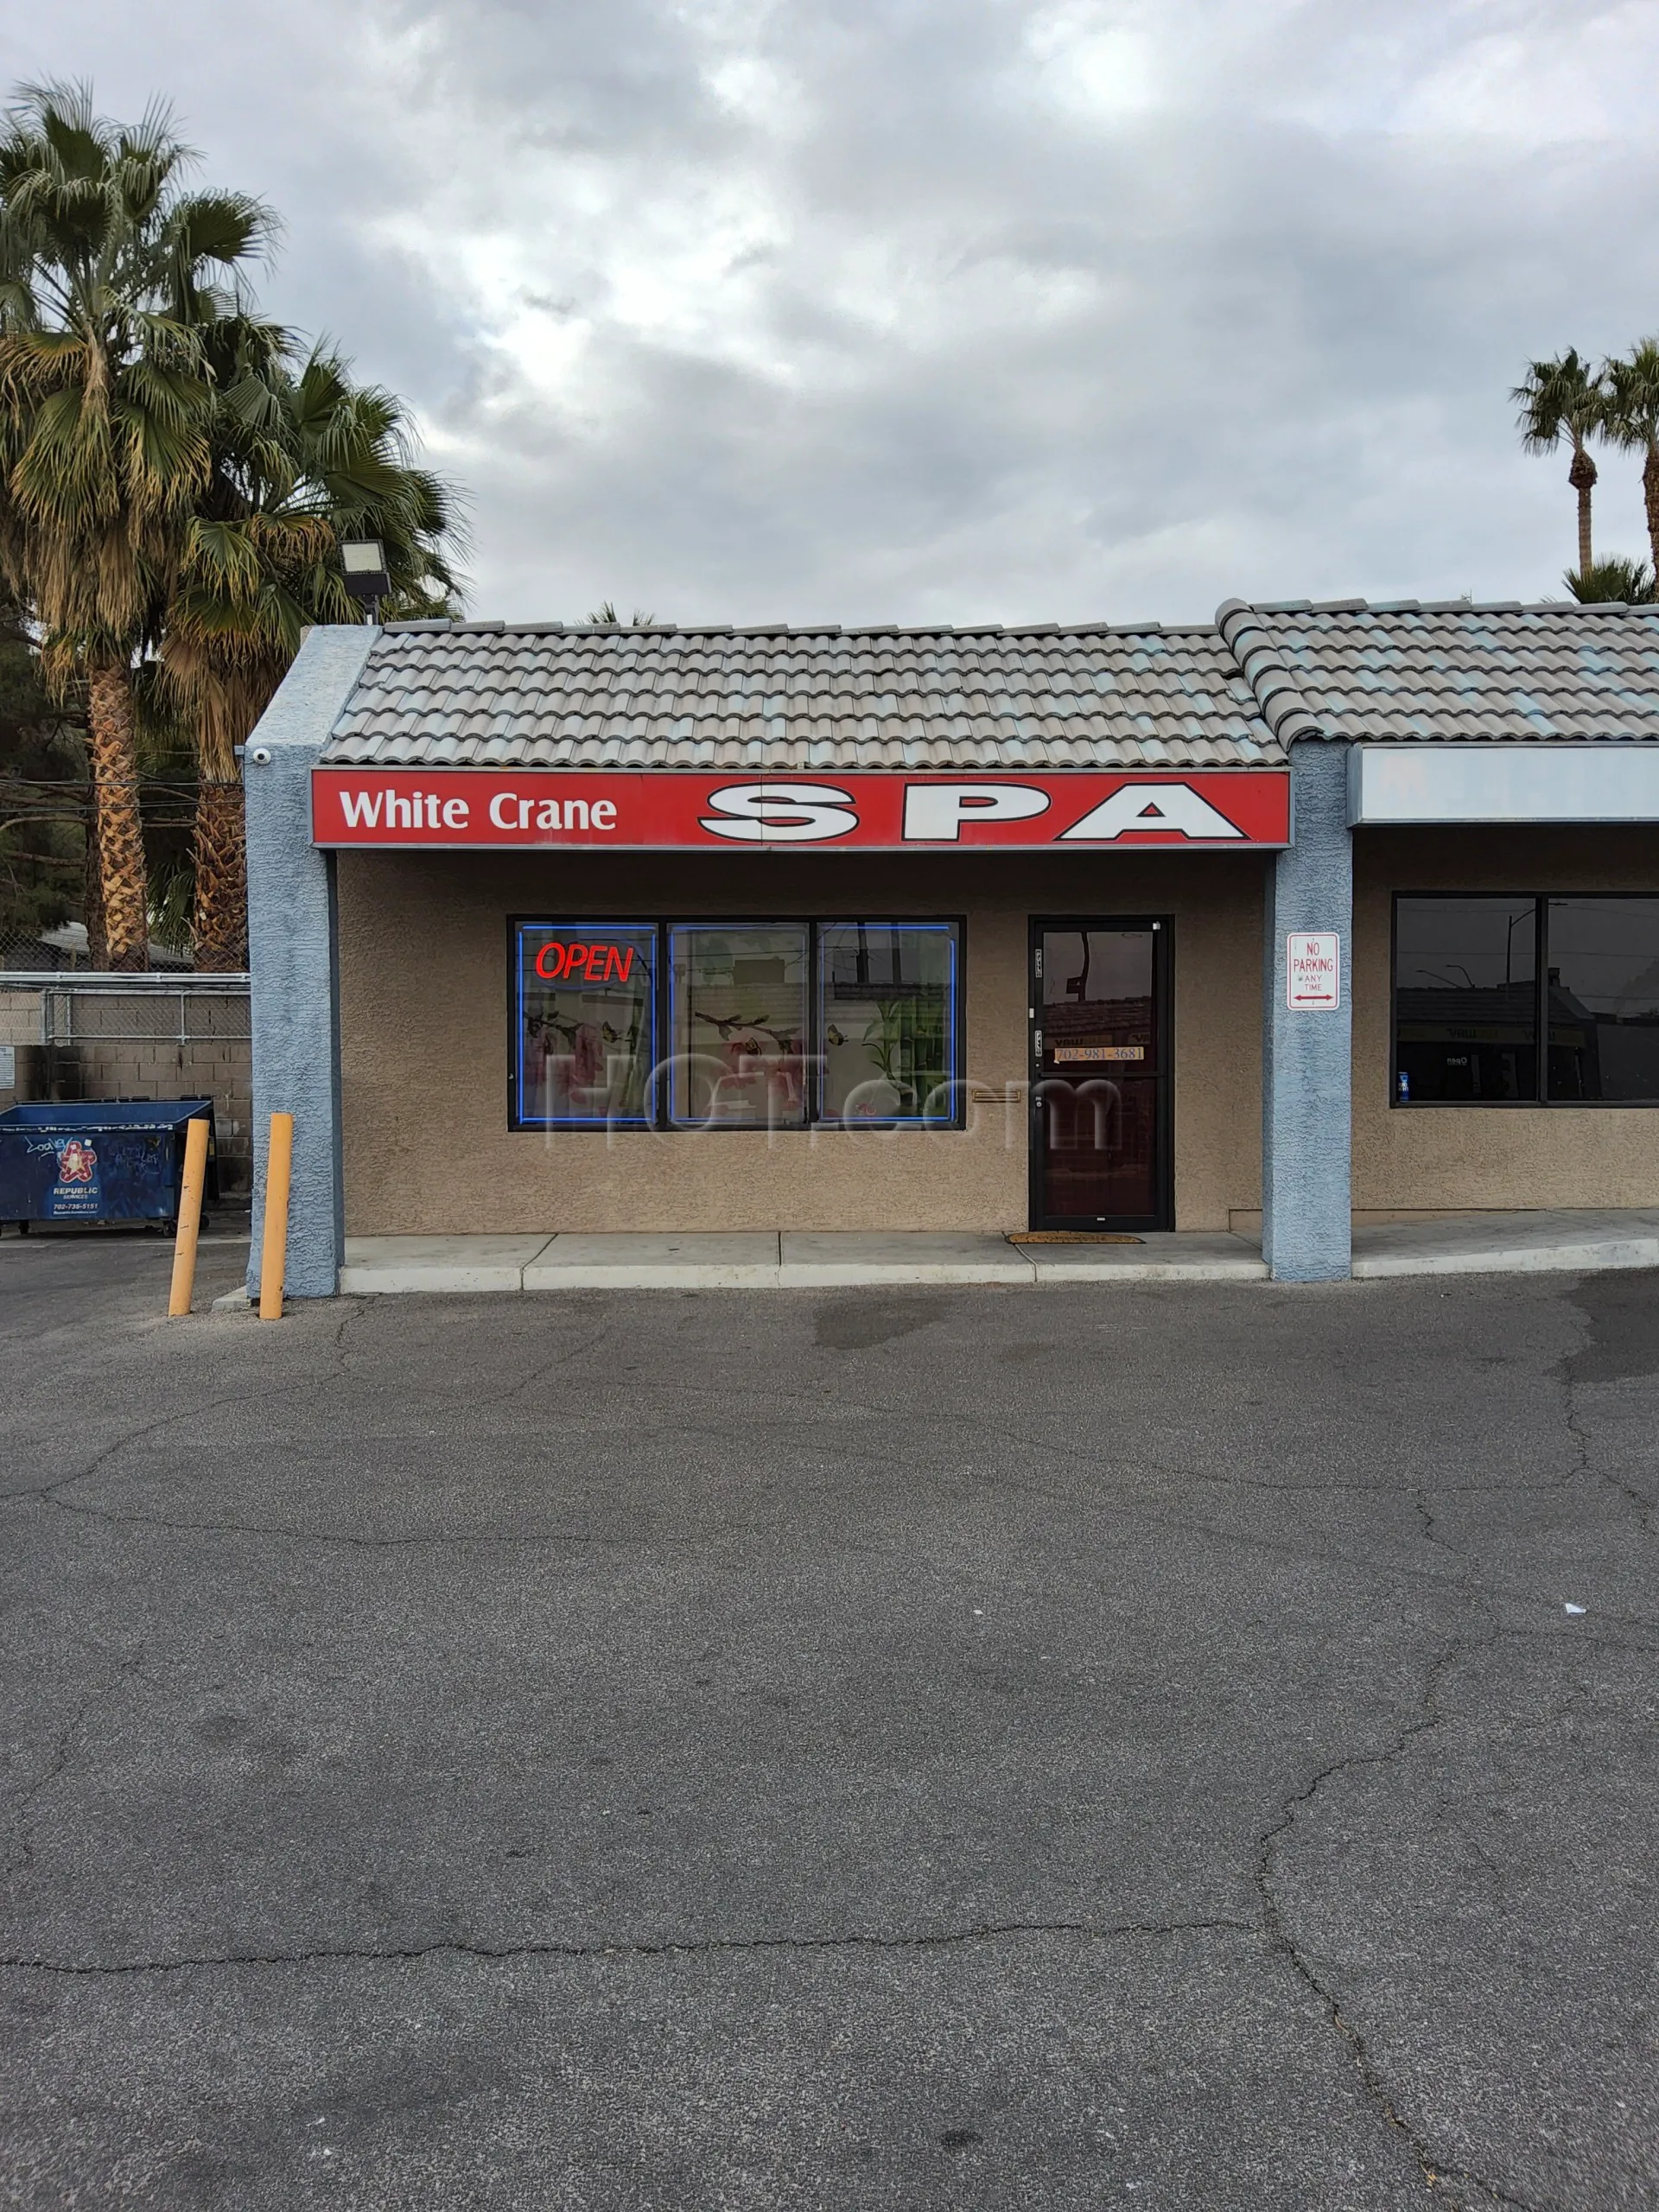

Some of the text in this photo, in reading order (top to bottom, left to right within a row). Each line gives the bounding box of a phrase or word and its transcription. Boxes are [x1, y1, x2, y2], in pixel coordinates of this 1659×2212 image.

[339, 782, 1250, 842] White Crane SPA
[1306, 942, 1319, 956] NO
[536, 942, 633, 982] OPEN
[1294, 958, 1333, 972] PARKING
[1056, 1048, 1142, 1060] 702-981-3681
